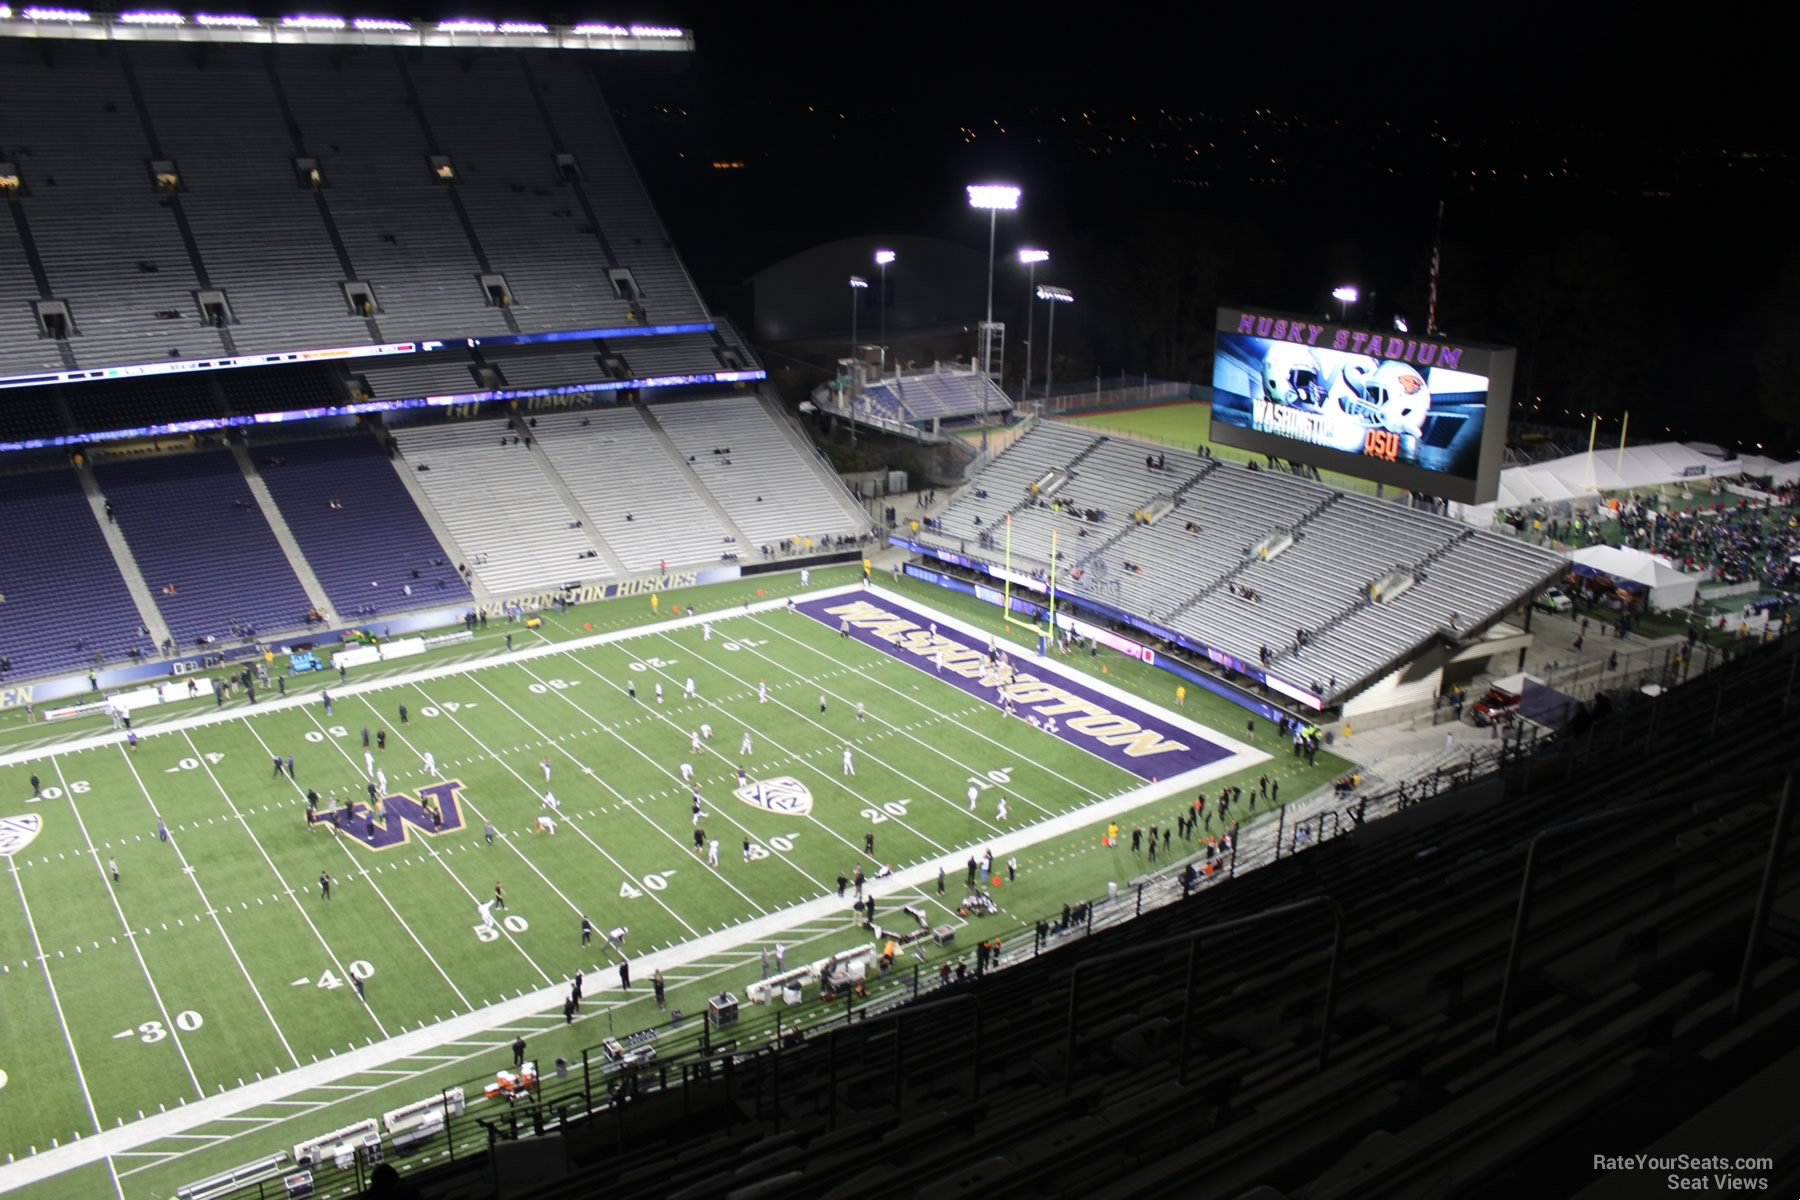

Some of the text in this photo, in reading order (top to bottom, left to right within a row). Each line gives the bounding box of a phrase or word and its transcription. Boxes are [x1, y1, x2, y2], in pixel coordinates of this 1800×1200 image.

[1237, 313, 1463, 369] HUSKY STADIUM
[1365, 429, 1400, 457] OSU
[617, 572, 698, 597] HUSKIES
[823, 600, 1191, 758] WASHINGTON
[860, 801, 908, 824] 20
[619, 873, 668, 899] 40
[316, 960, 375, 990] 40
[138, 1010, 204, 1043] 30
